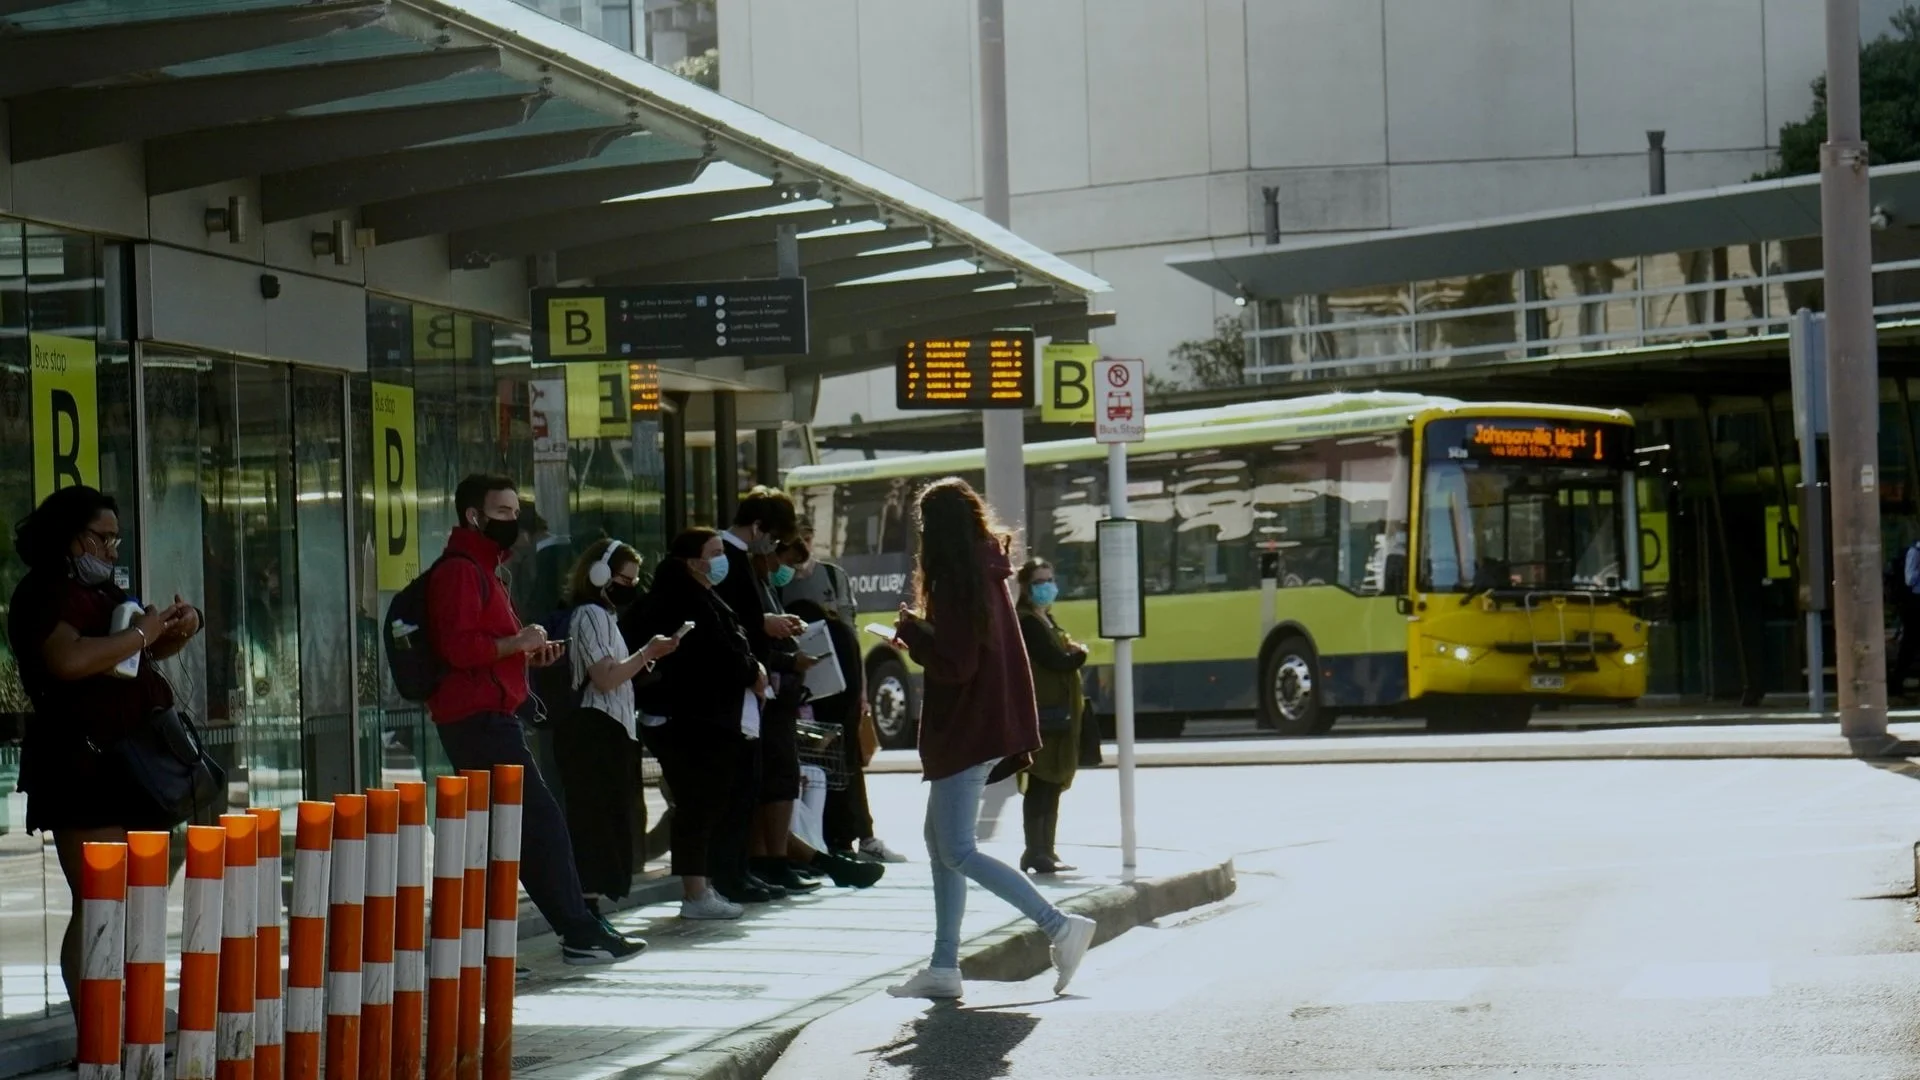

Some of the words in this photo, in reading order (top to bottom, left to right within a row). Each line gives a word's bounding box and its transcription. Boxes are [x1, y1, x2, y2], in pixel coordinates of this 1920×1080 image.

[565, 310, 592, 345] B
[34, 344, 49, 371] Bus
[51, 350, 67, 376] stop
[1054, 360, 1090, 409] B
[375, 392, 385, 412] Bus
[385, 395, 395, 416] stop
[1099, 424, 1118, 434] Bus
[1120, 423, 1144, 436] Stop
[1474, 424, 1551, 445] Johnsonville
[1555, 428, 1586, 447] West
[1594, 430, 1602, 459] 1
[385, 427, 407, 556] B
[859, 575, 879, 593] our
[879, 573, 906, 594] way
